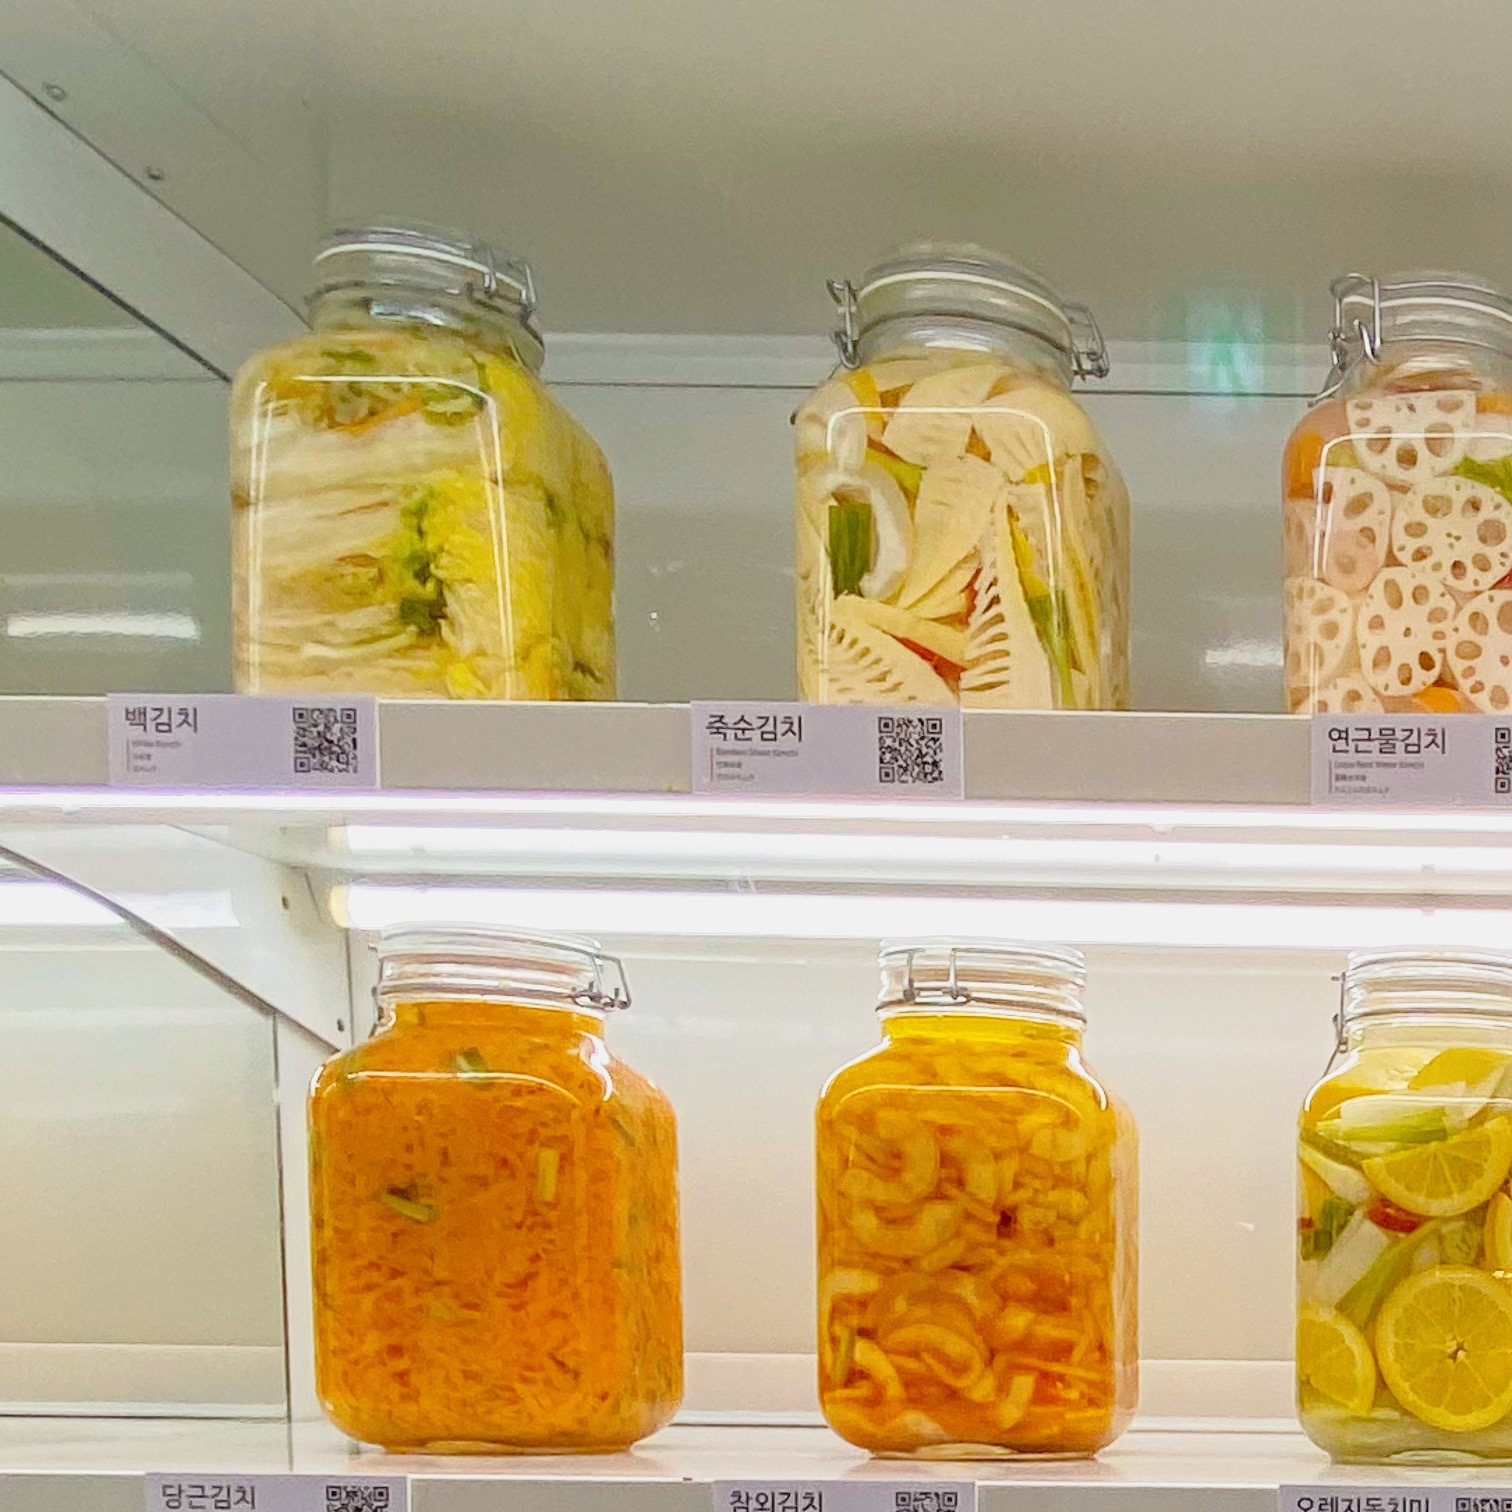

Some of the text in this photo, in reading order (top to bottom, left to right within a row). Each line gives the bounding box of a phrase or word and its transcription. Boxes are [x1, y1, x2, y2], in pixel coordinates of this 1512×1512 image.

[124, 706, 198, 734] 백김치
[705, 714, 803, 743] 죽순김치
[1328, 727, 1446, 755] 연근물김치
[162, 1484, 256, 1510] 당근김치
